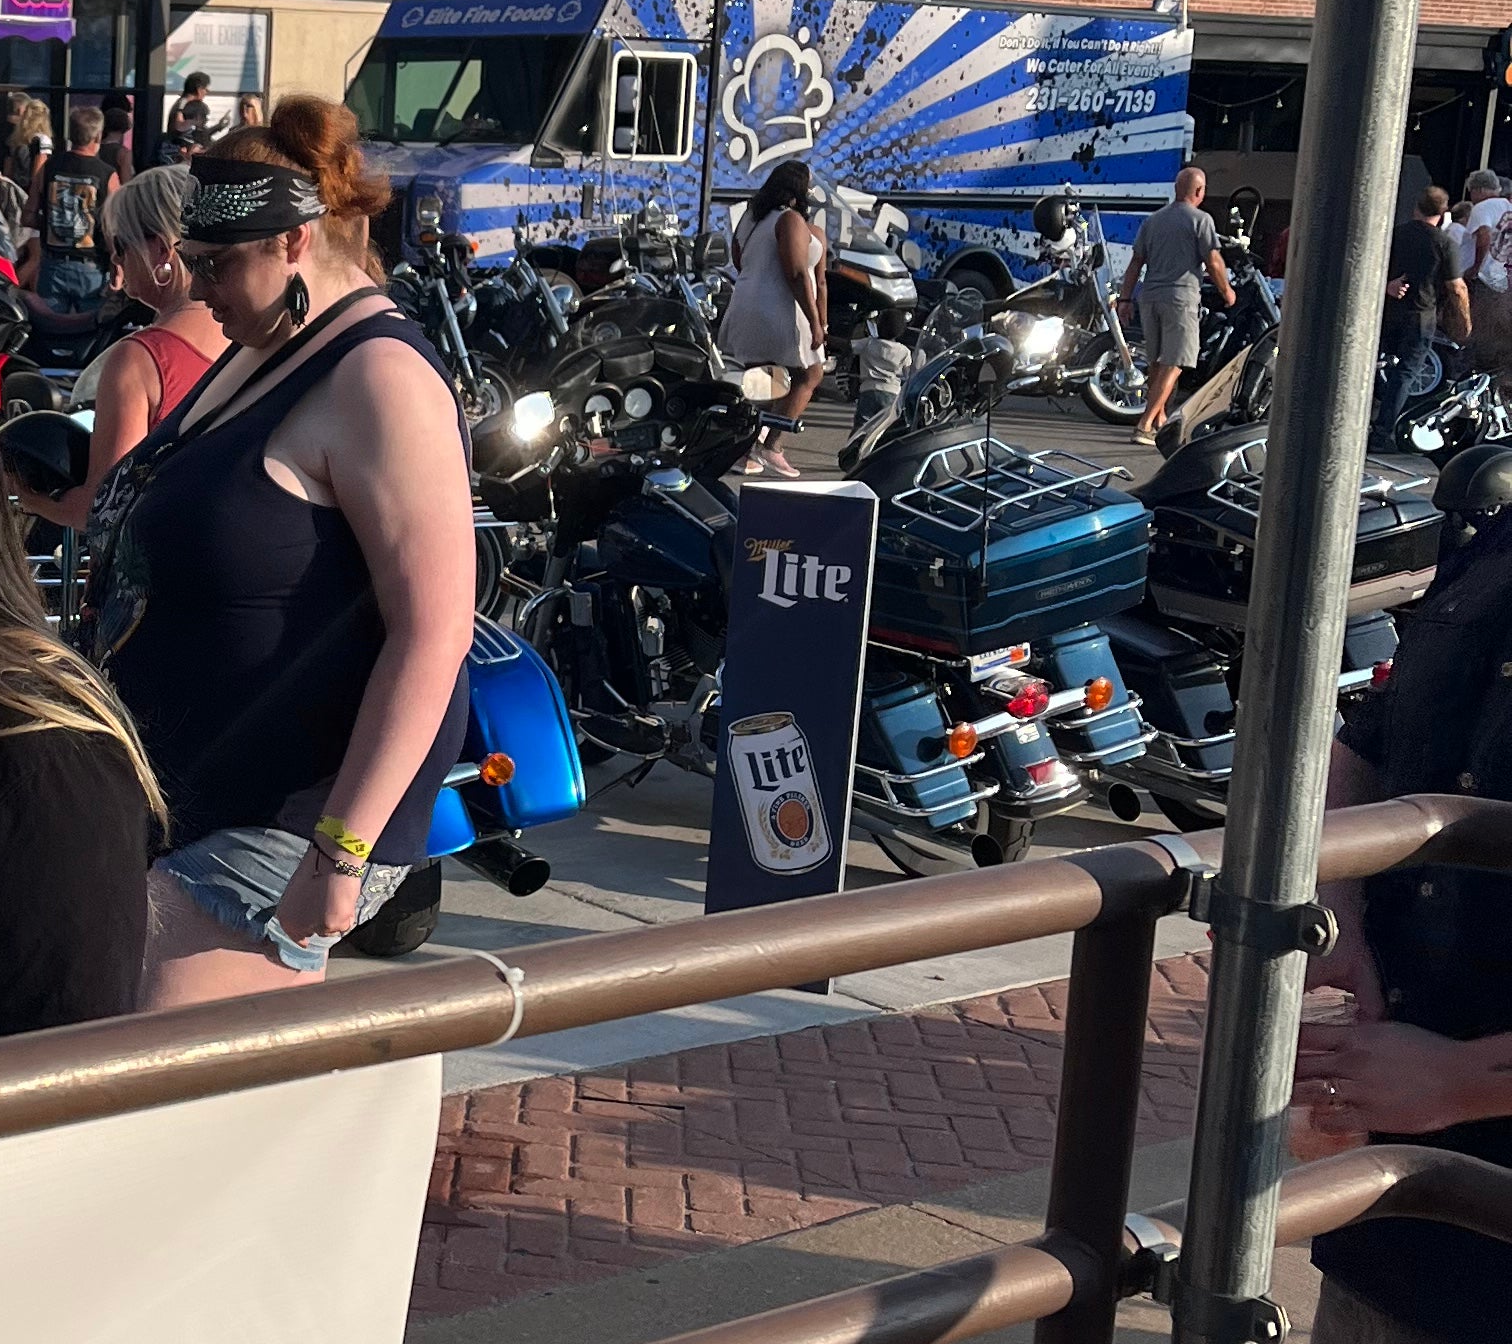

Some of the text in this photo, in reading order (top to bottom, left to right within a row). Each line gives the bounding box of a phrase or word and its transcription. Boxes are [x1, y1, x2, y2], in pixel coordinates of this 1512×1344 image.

[423, 4, 556, 26] Elite Fine Foods
[1026, 58, 1161, 78] We Cater For All Events
[1024, 86, 1157, 113] 231-260-7139
[757, 548, 852, 609] Lite
[744, 744, 806, 792] Lite
